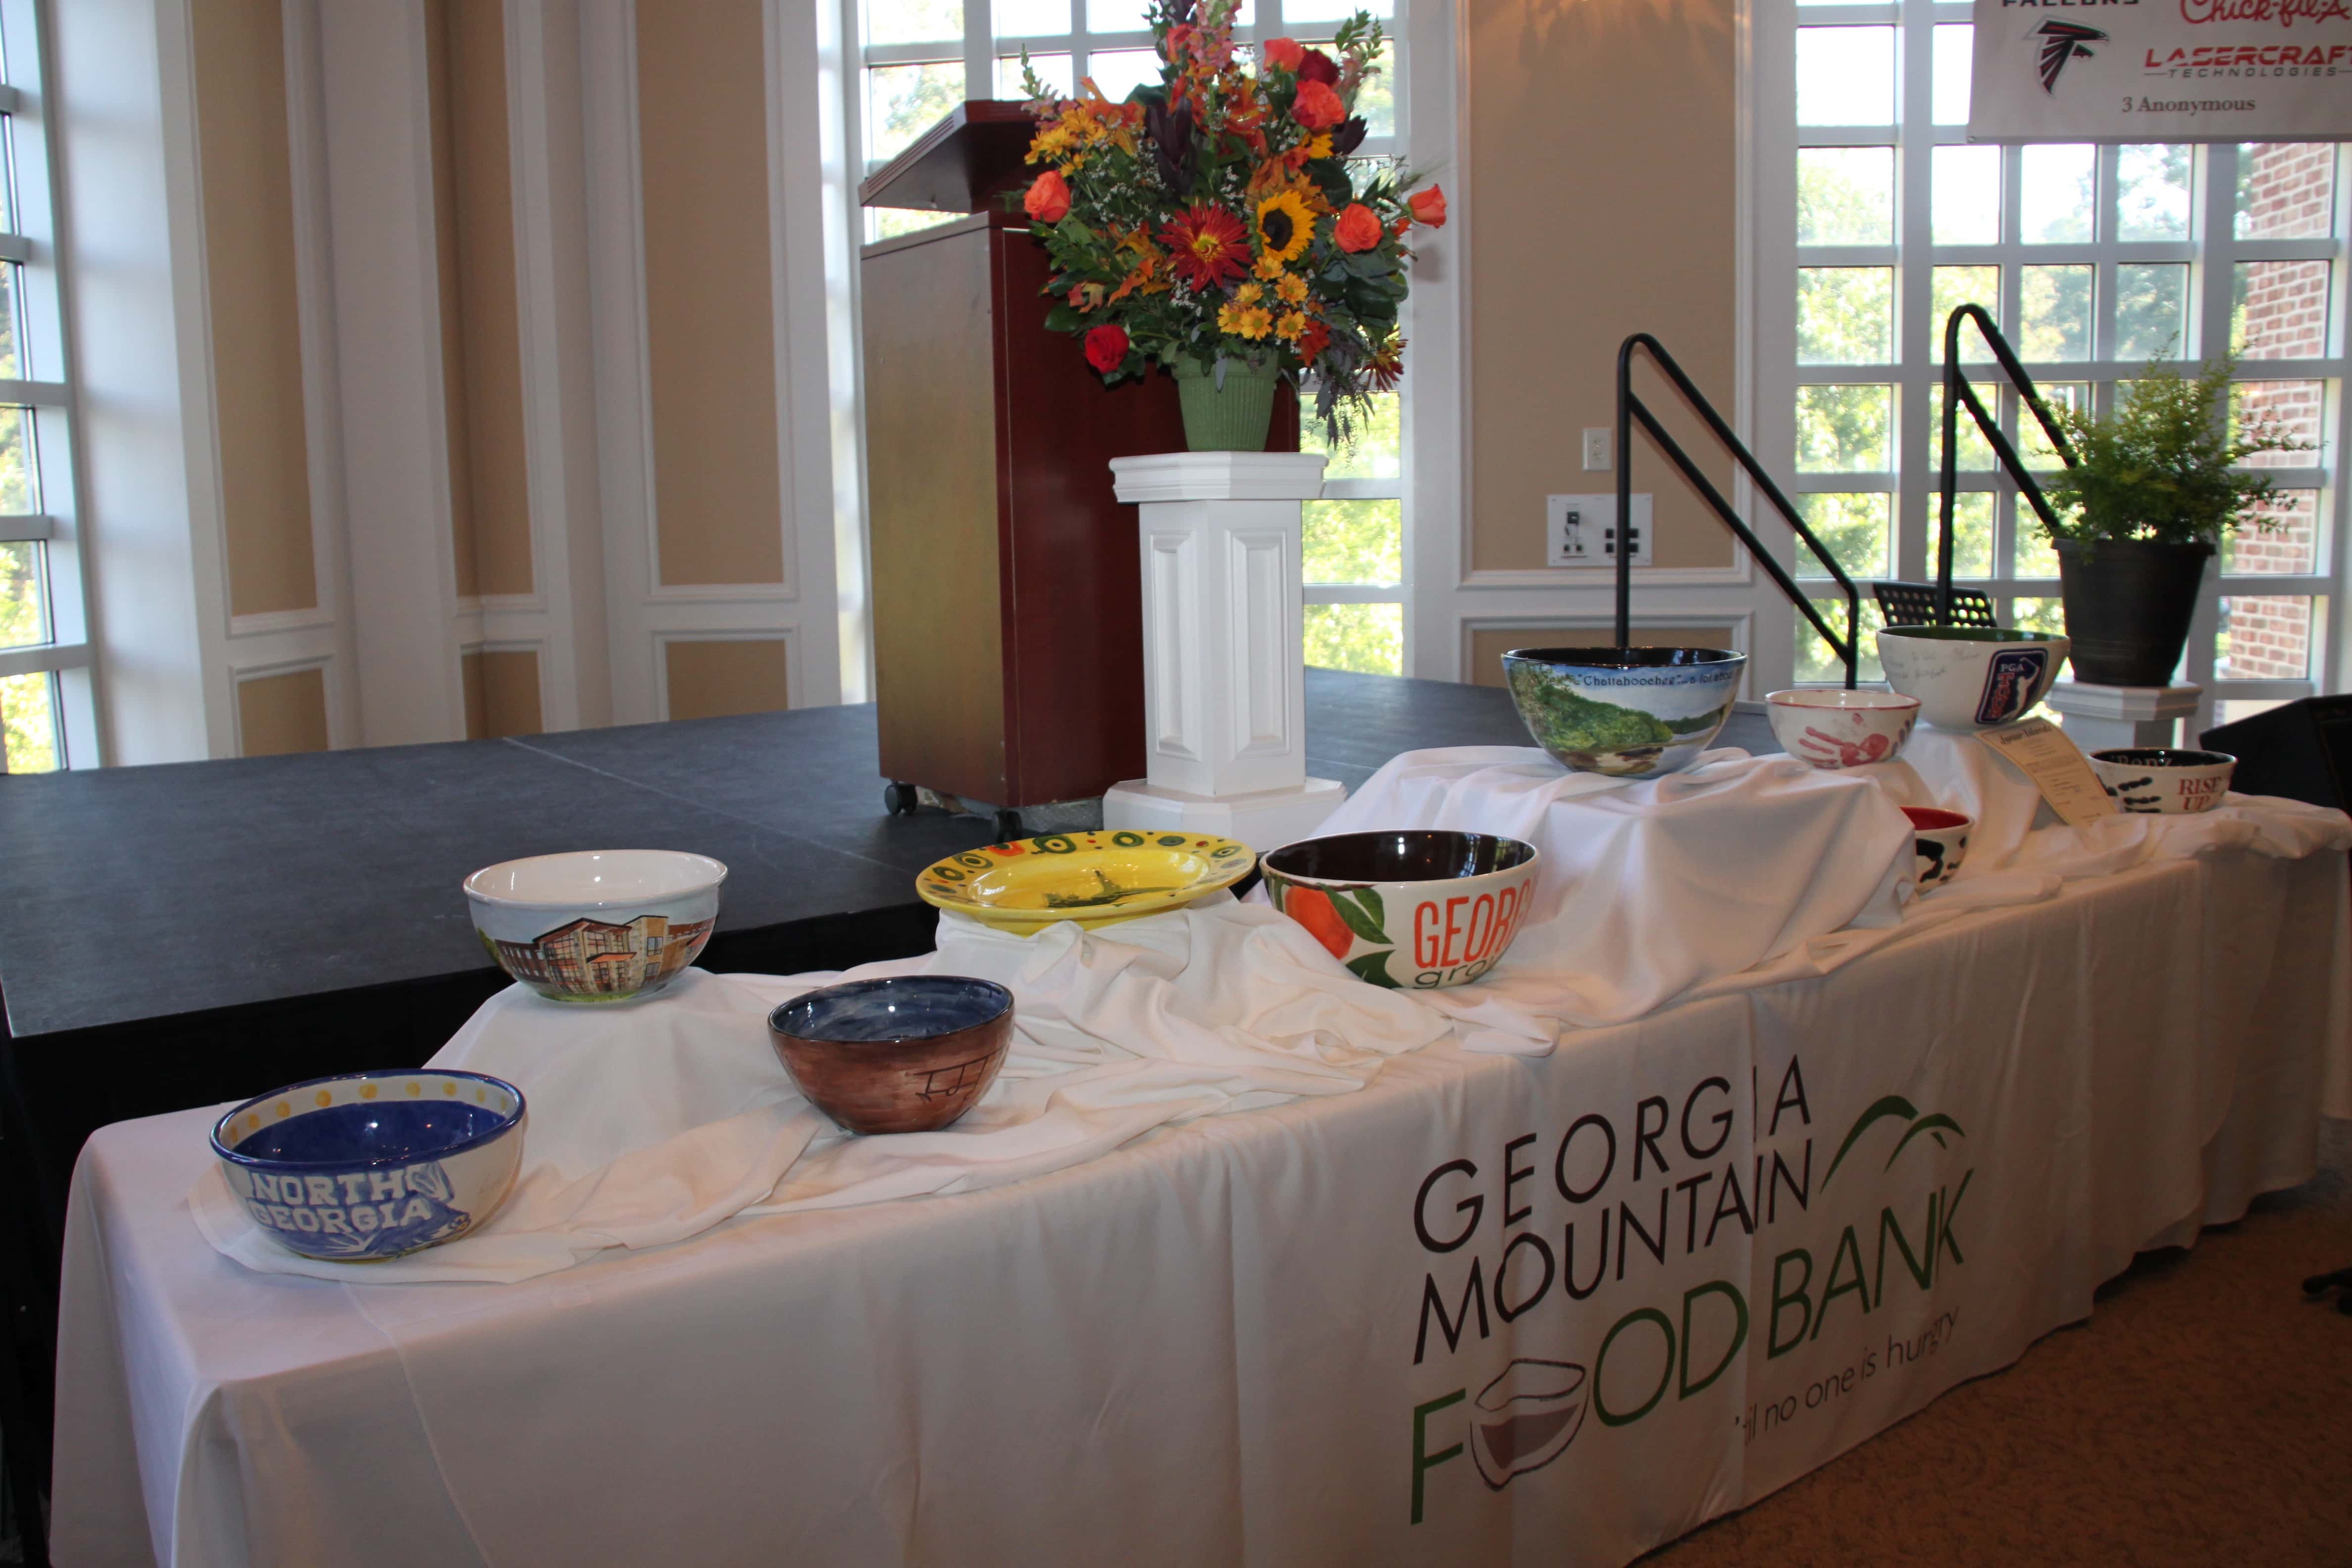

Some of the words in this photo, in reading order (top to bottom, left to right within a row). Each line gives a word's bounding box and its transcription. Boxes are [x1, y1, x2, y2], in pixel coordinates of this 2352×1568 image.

[2145, 45, 2352, 68] LASERCRAF
[2169, 67, 2337, 78] TECHNOLOGIES
[2122, 97, 2132, 112] 3
[2137, 96, 2256, 116] Anonymous
[1999, 663, 2025, 673] PGA
[2178, 776, 2222, 795] RISE
[2183, 795, 2210, 811] UP
[1413, 1054, 1812, 1254] GEORGIA
[250, 1169, 406, 1206] NORTH
[247, 1196, 432, 1233] GEORGIA
[1413, 1138, 1813, 1366] MOUNTAIN
[1766, 1168, 1975, 1361] BANK
[1764, 1395, 1797, 1431] no
[1805, 1367, 1855, 1409] one
[1861, 1346, 1877, 1380] is
